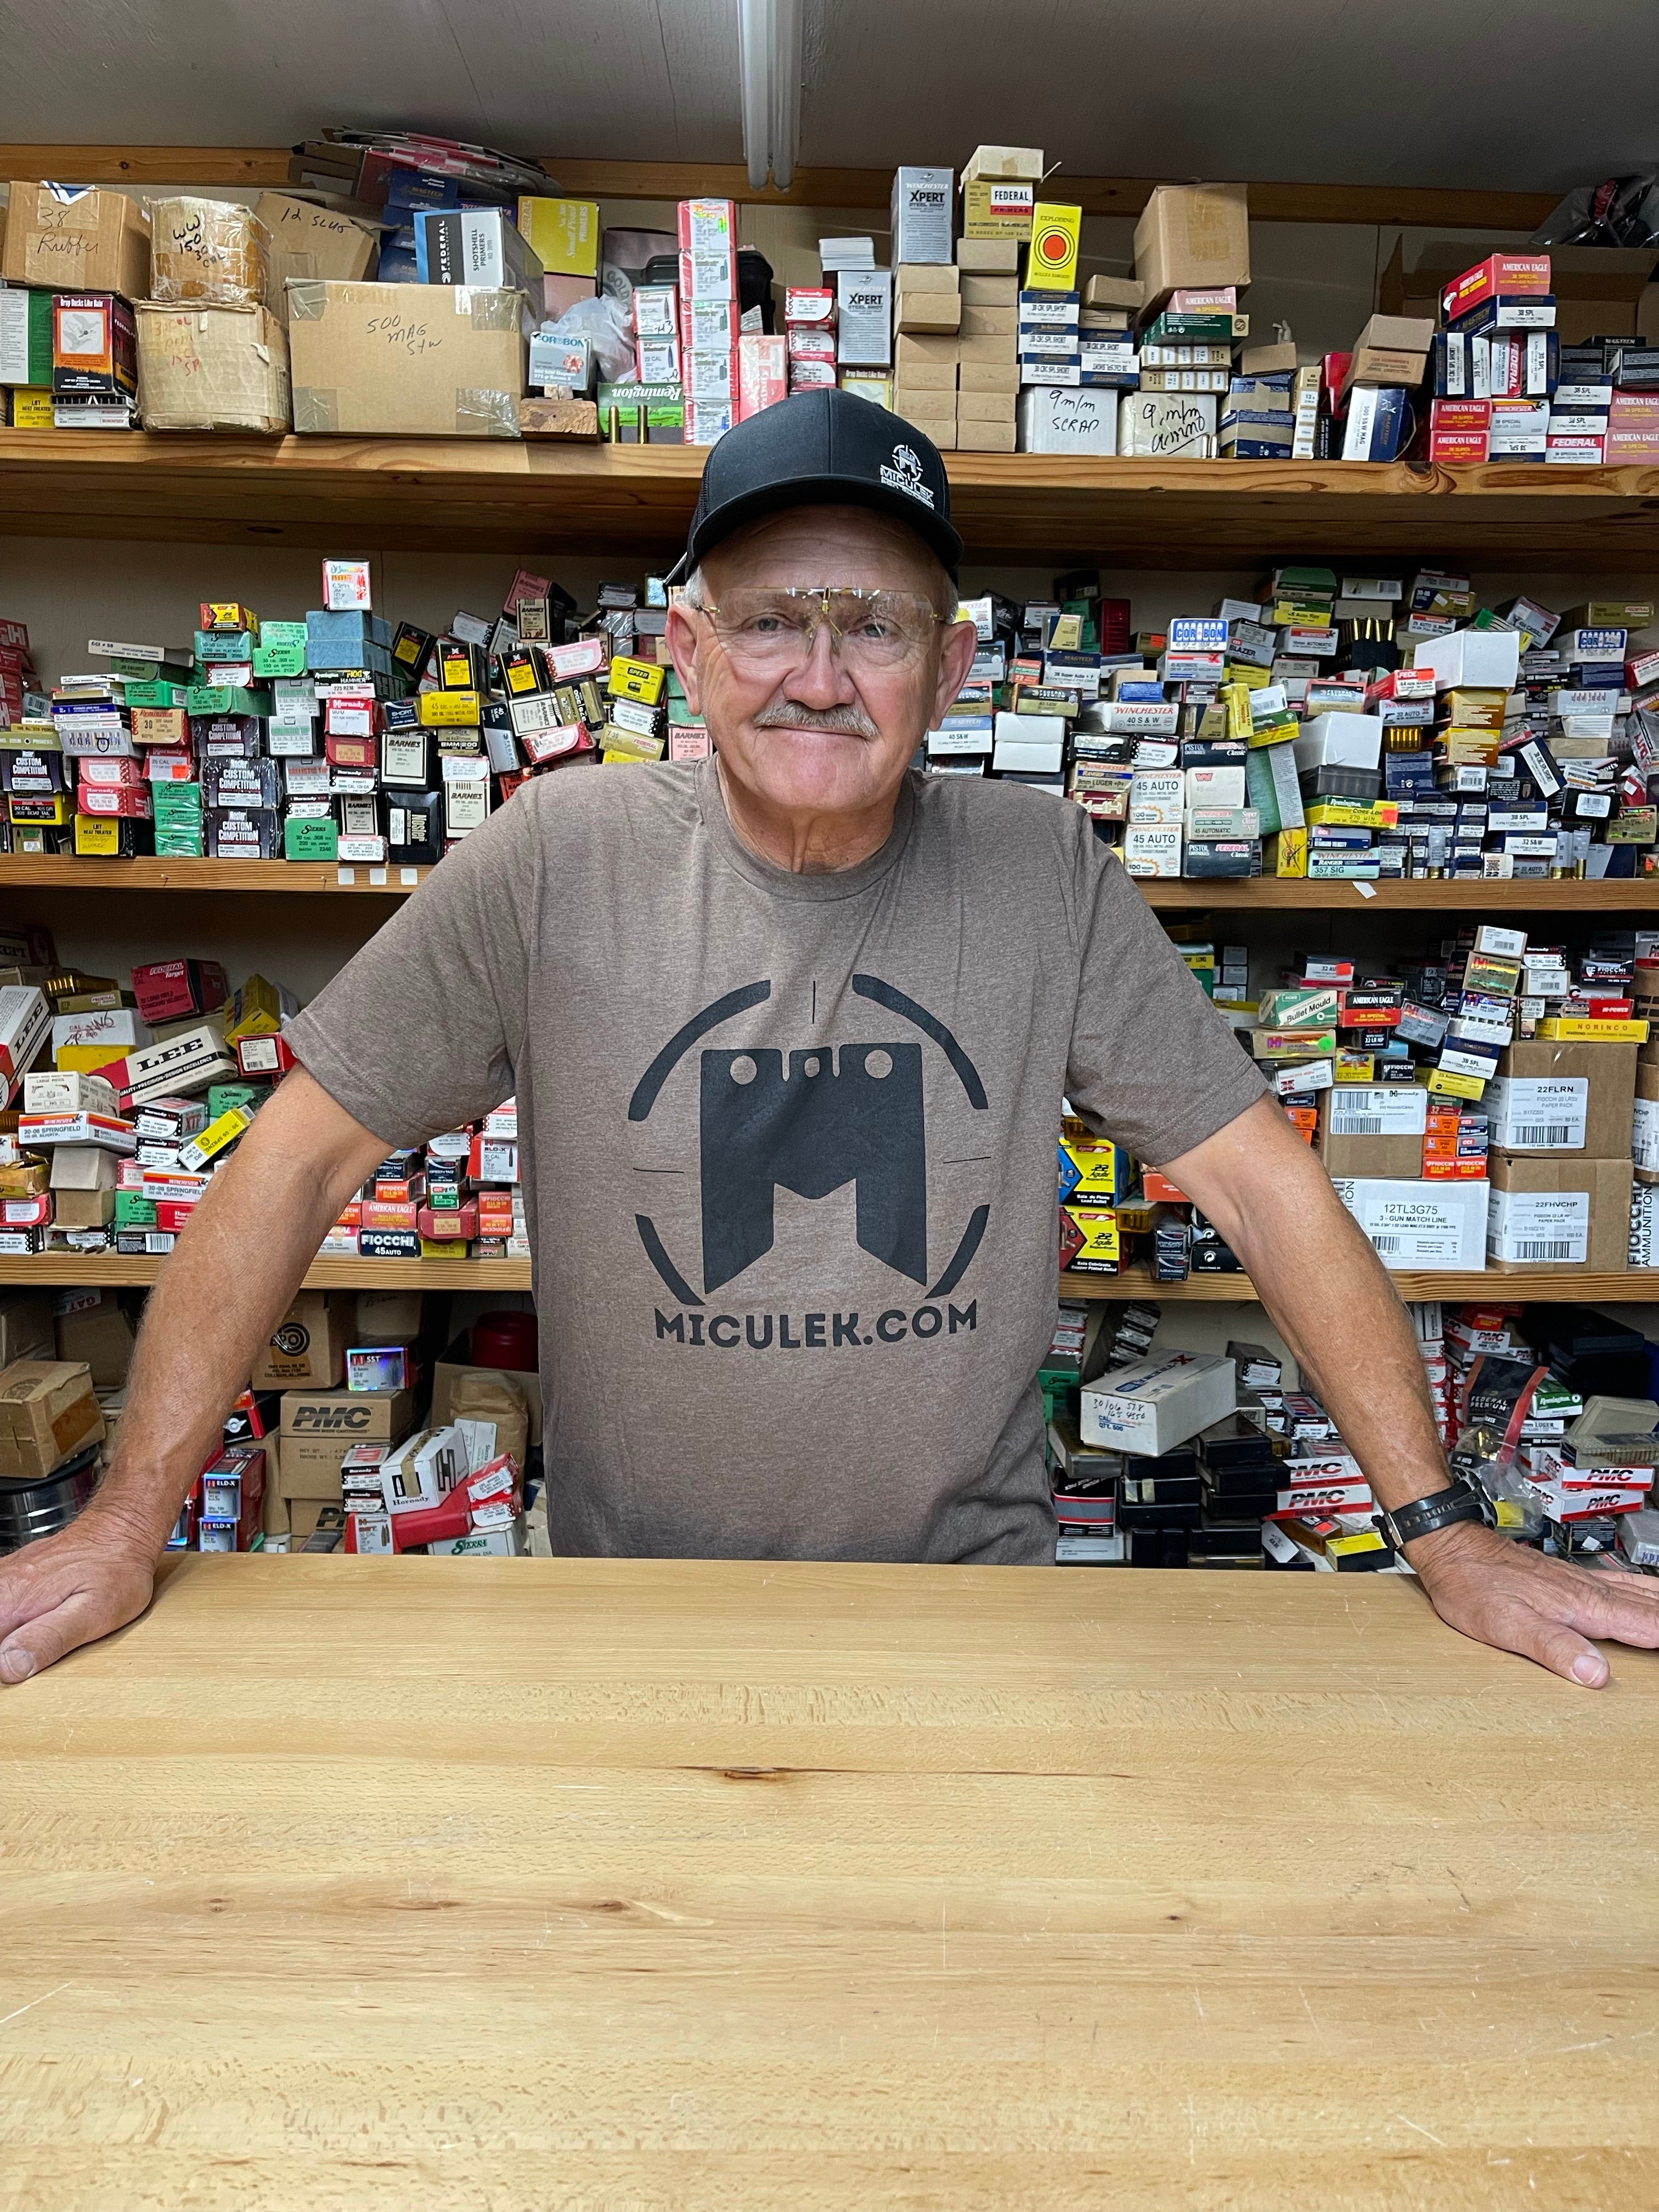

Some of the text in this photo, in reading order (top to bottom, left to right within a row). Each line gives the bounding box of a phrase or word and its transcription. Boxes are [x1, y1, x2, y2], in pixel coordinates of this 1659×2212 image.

[910, 190, 945, 202] XPERT
[995, 191, 1029, 200] FEDERAL
[849, 294, 882, 305] XPERT
[1509, 342, 1519, 389] FEDERAL
[1552, 438, 1596, 447] FEDERAL
[1229, 645, 1256, 656] BLAZER
[333, 699, 365, 708] Hornady
[144, 720, 153, 729] 30
[211, 723, 236, 732] CUSTOM
[15, 758, 42, 766] CUSTOM
[1084, 763, 1127, 771] WINCHESTER
[223, 769, 255, 779] CUSTOM
[219, 778, 261, 789] COMPETITION
[1137, 781, 1178, 790] 45 AUTO
[223, 821, 252, 831] CUSTOM
[411, 814, 427, 842] Nosler
[219, 830, 259, 841] COMPETITION
[1133, 835, 1176, 844] 45 AUTO
[1353, 996, 1378, 1005] AMERICAN
[1286, 997, 1331, 1023] Bullet Mould
[13, 1001, 44, 1053] LEE
[137, 1038, 204, 1072] LEE
[369, 1203, 414, 1214] AMERICAN EAGLE
[1384, 1204, 1437, 1215] 12TL3G75
[1641, 1186, 1652, 1267] AMMUNITION
[361, 1234, 414, 1247] FIOCCHI
[654, 1299, 977, 1349] MICULEK.COM
[292, 1407, 371, 1429] PMC
[1587, 1469, 1633, 1481] PMC
[393, 1496, 429, 1505] Hornady
[1289, 1489, 1346, 1508] PMC
[1587, 1494, 1621, 1509] PMC
